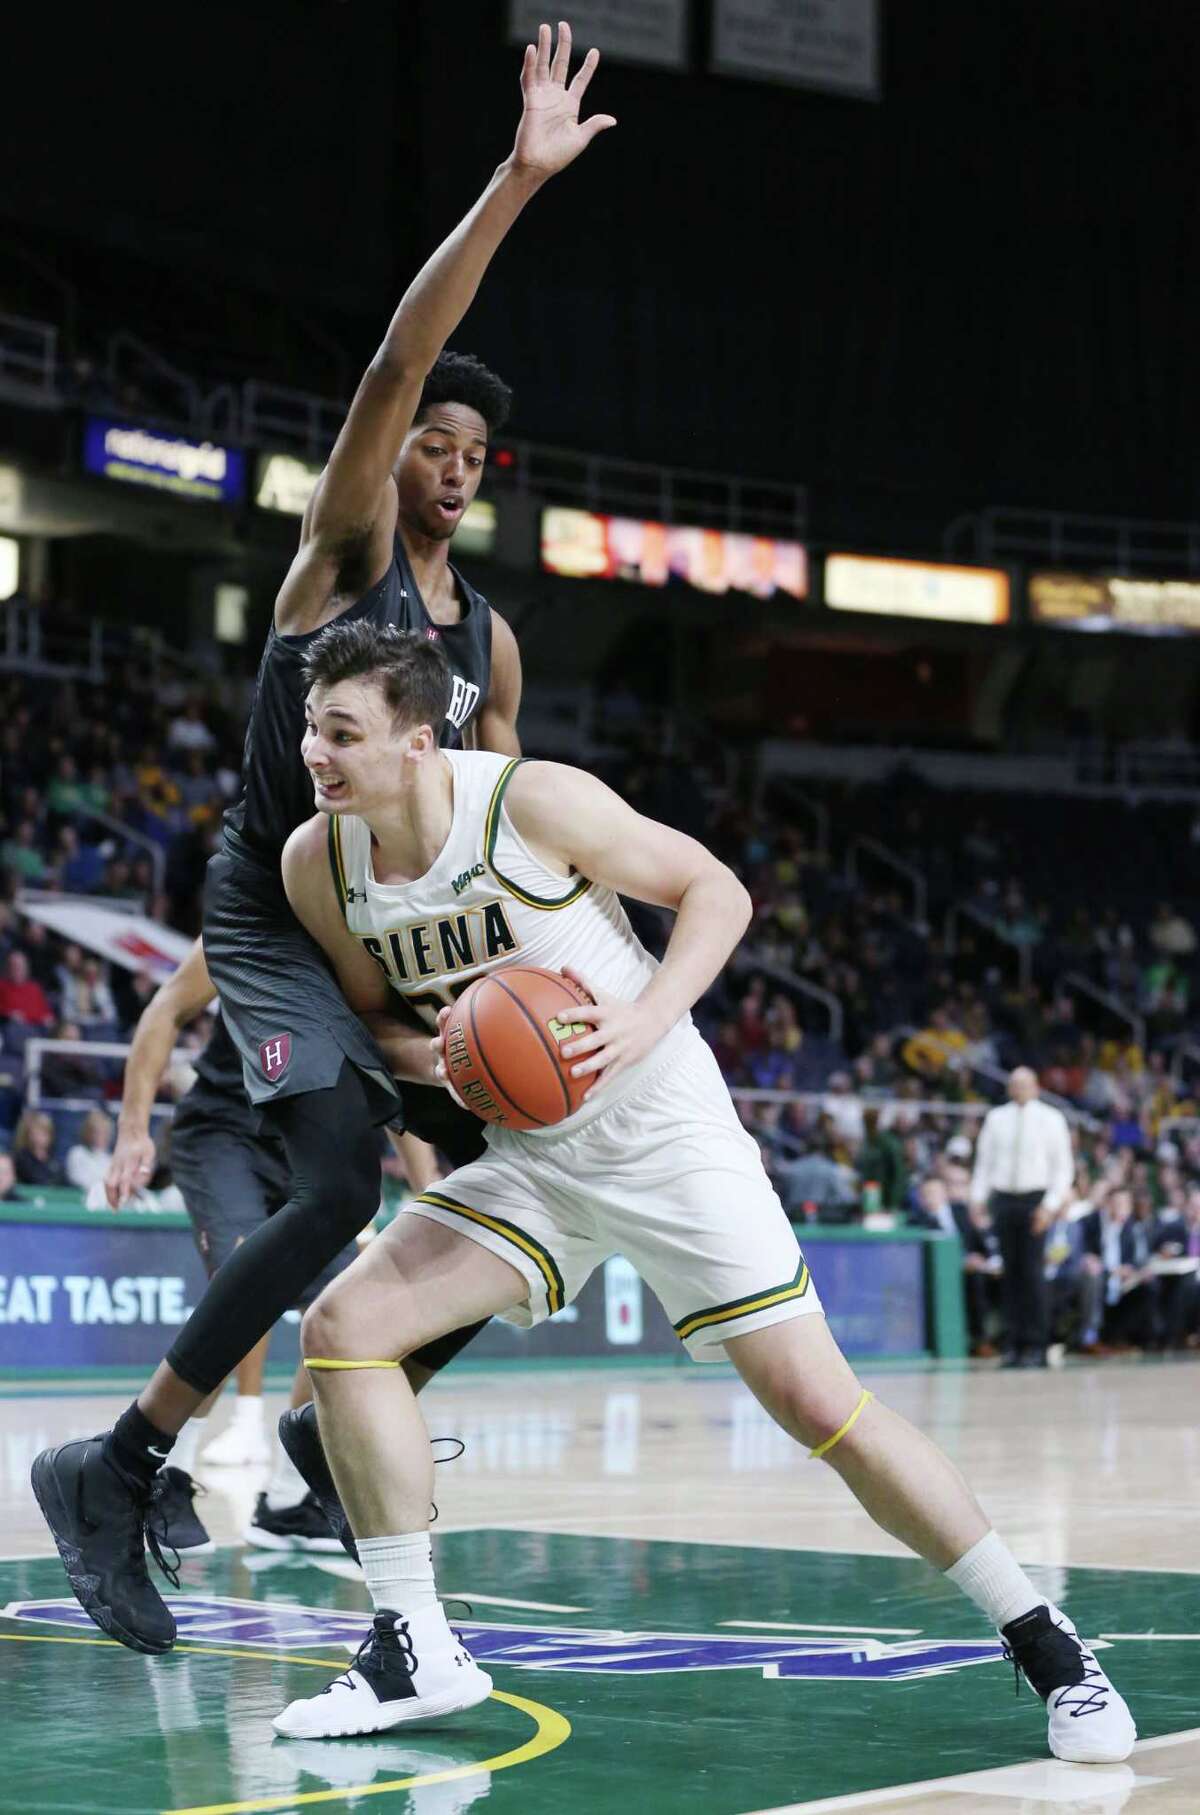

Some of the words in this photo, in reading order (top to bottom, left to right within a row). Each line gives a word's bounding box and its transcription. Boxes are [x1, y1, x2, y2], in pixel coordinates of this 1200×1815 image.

[360, 900, 519, 982] SIENA
[265, 1041, 282, 1071] H
[448, 1023, 473, 1073] THE
